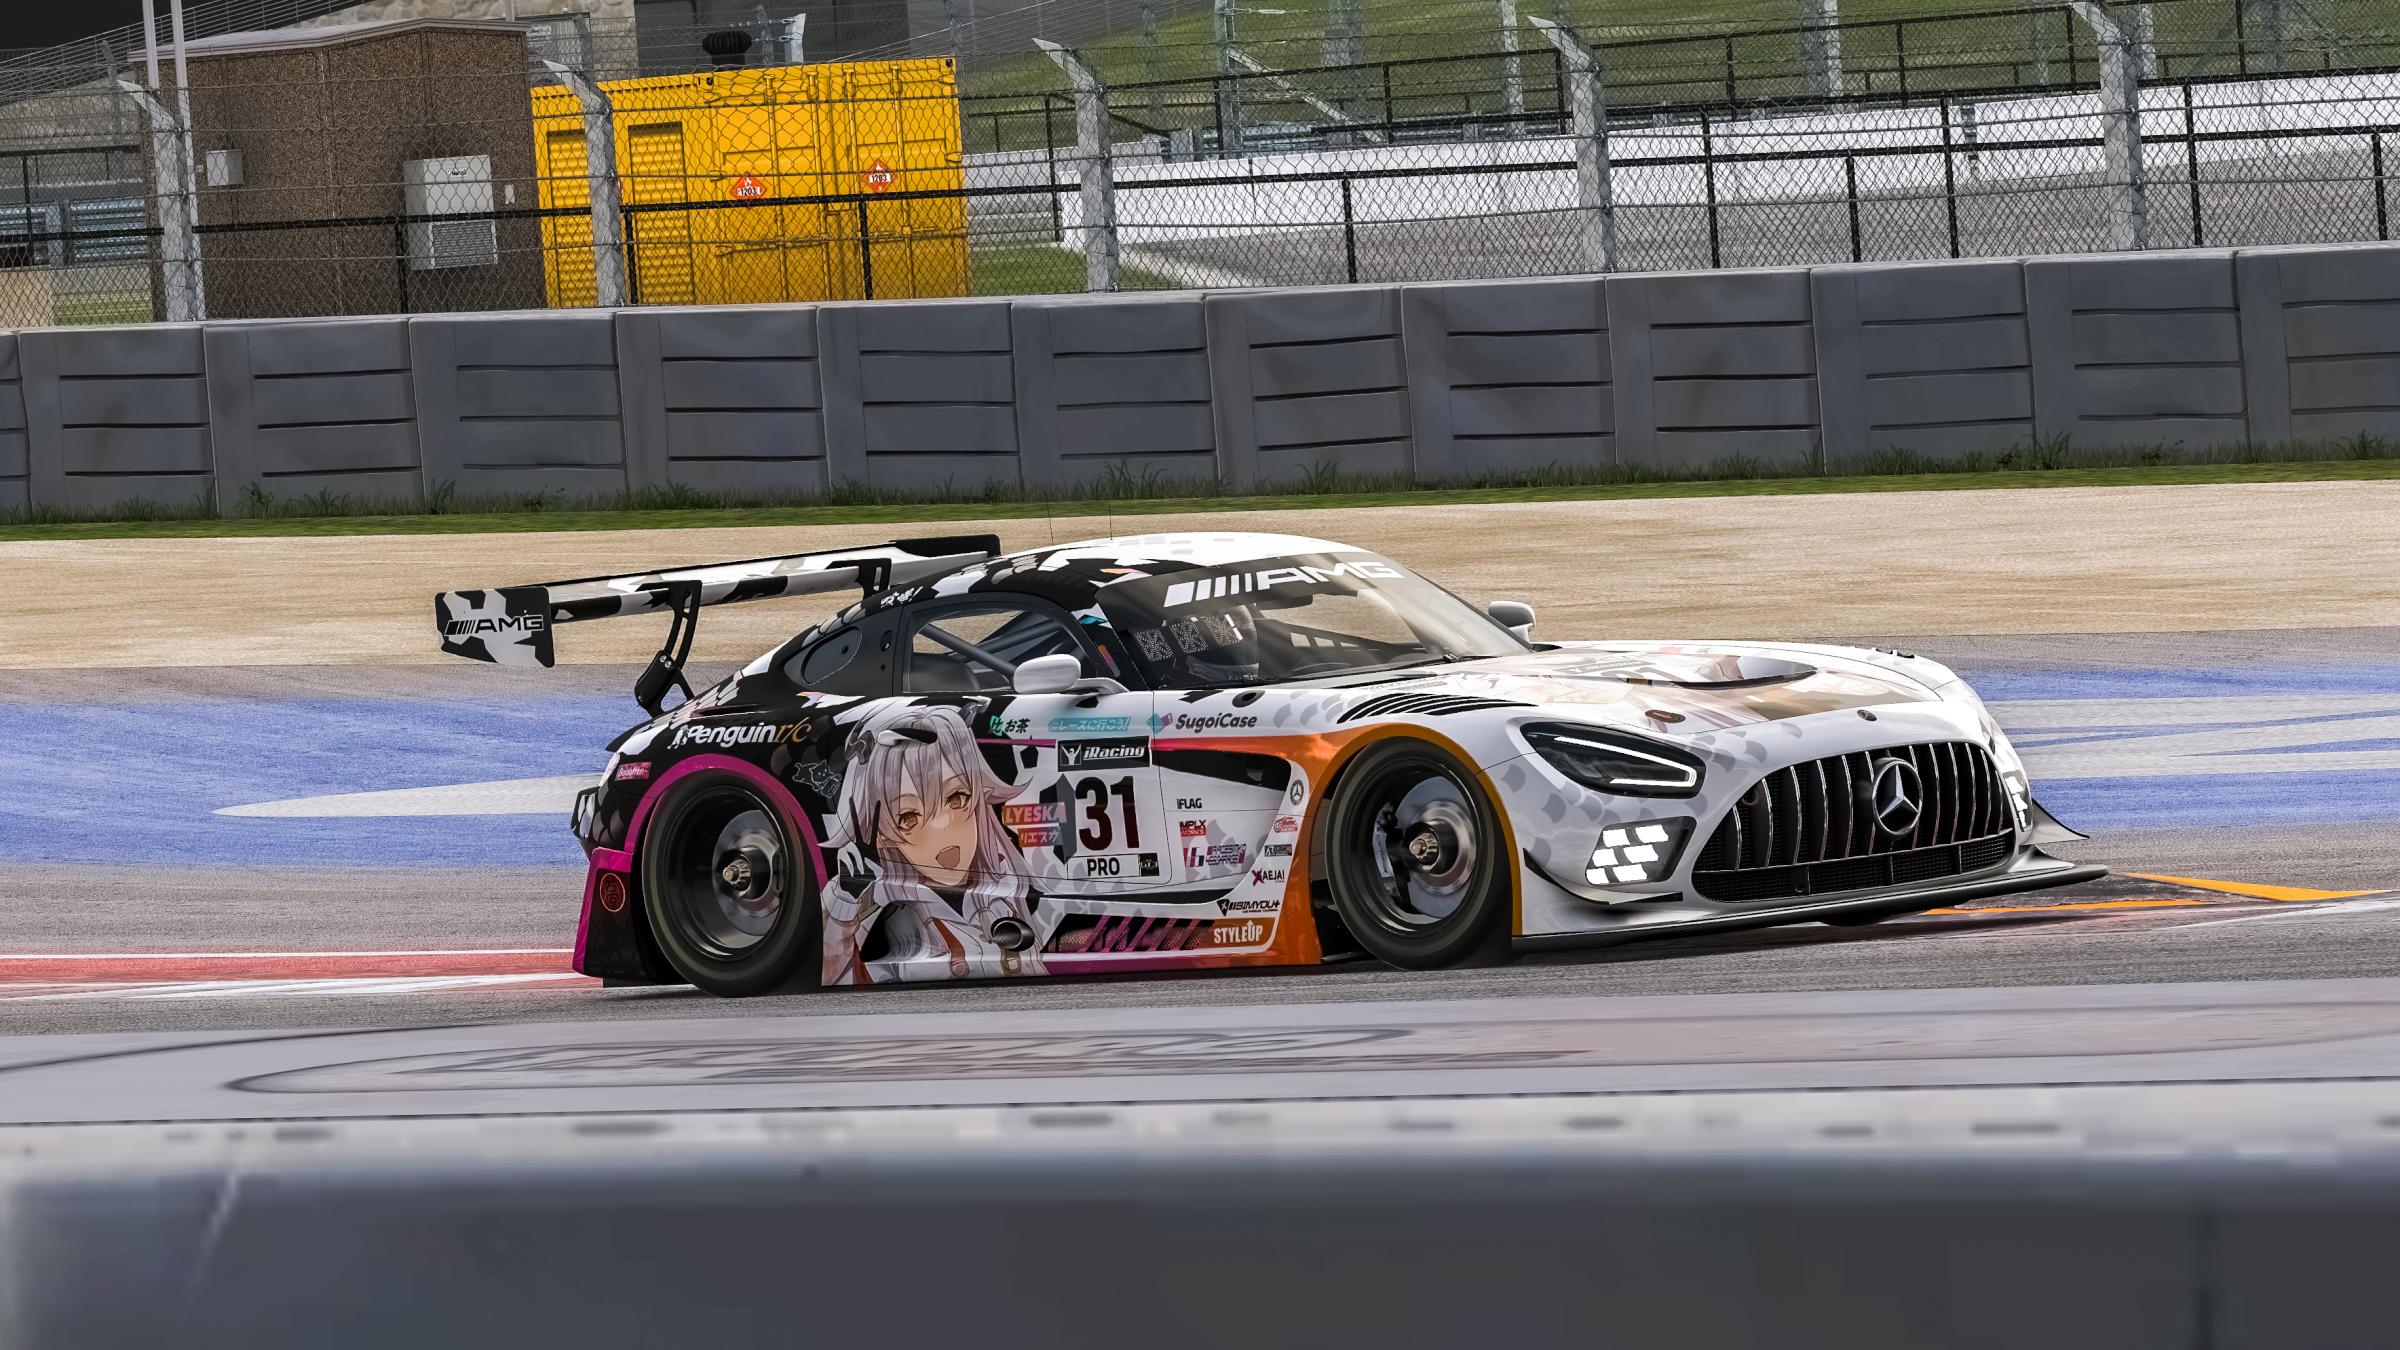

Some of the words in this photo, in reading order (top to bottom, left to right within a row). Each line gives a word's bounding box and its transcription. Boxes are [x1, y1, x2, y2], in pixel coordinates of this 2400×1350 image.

[870, 173, 889, 182] 1203
[1256, 561, 1405, 591] AMG
[474, 614, 544, 634] AMG
[1175, 712, 1258, 734] SugoiCase
[1083, 745, 1146, 760] iRacing
[1004, 801, 1068, 825] LYESKA
[1075, 775, 1140, 851] 31
[1087, 857, 1120, 876] PRO
[1213, 921, 1264, 944] STYLEUP
